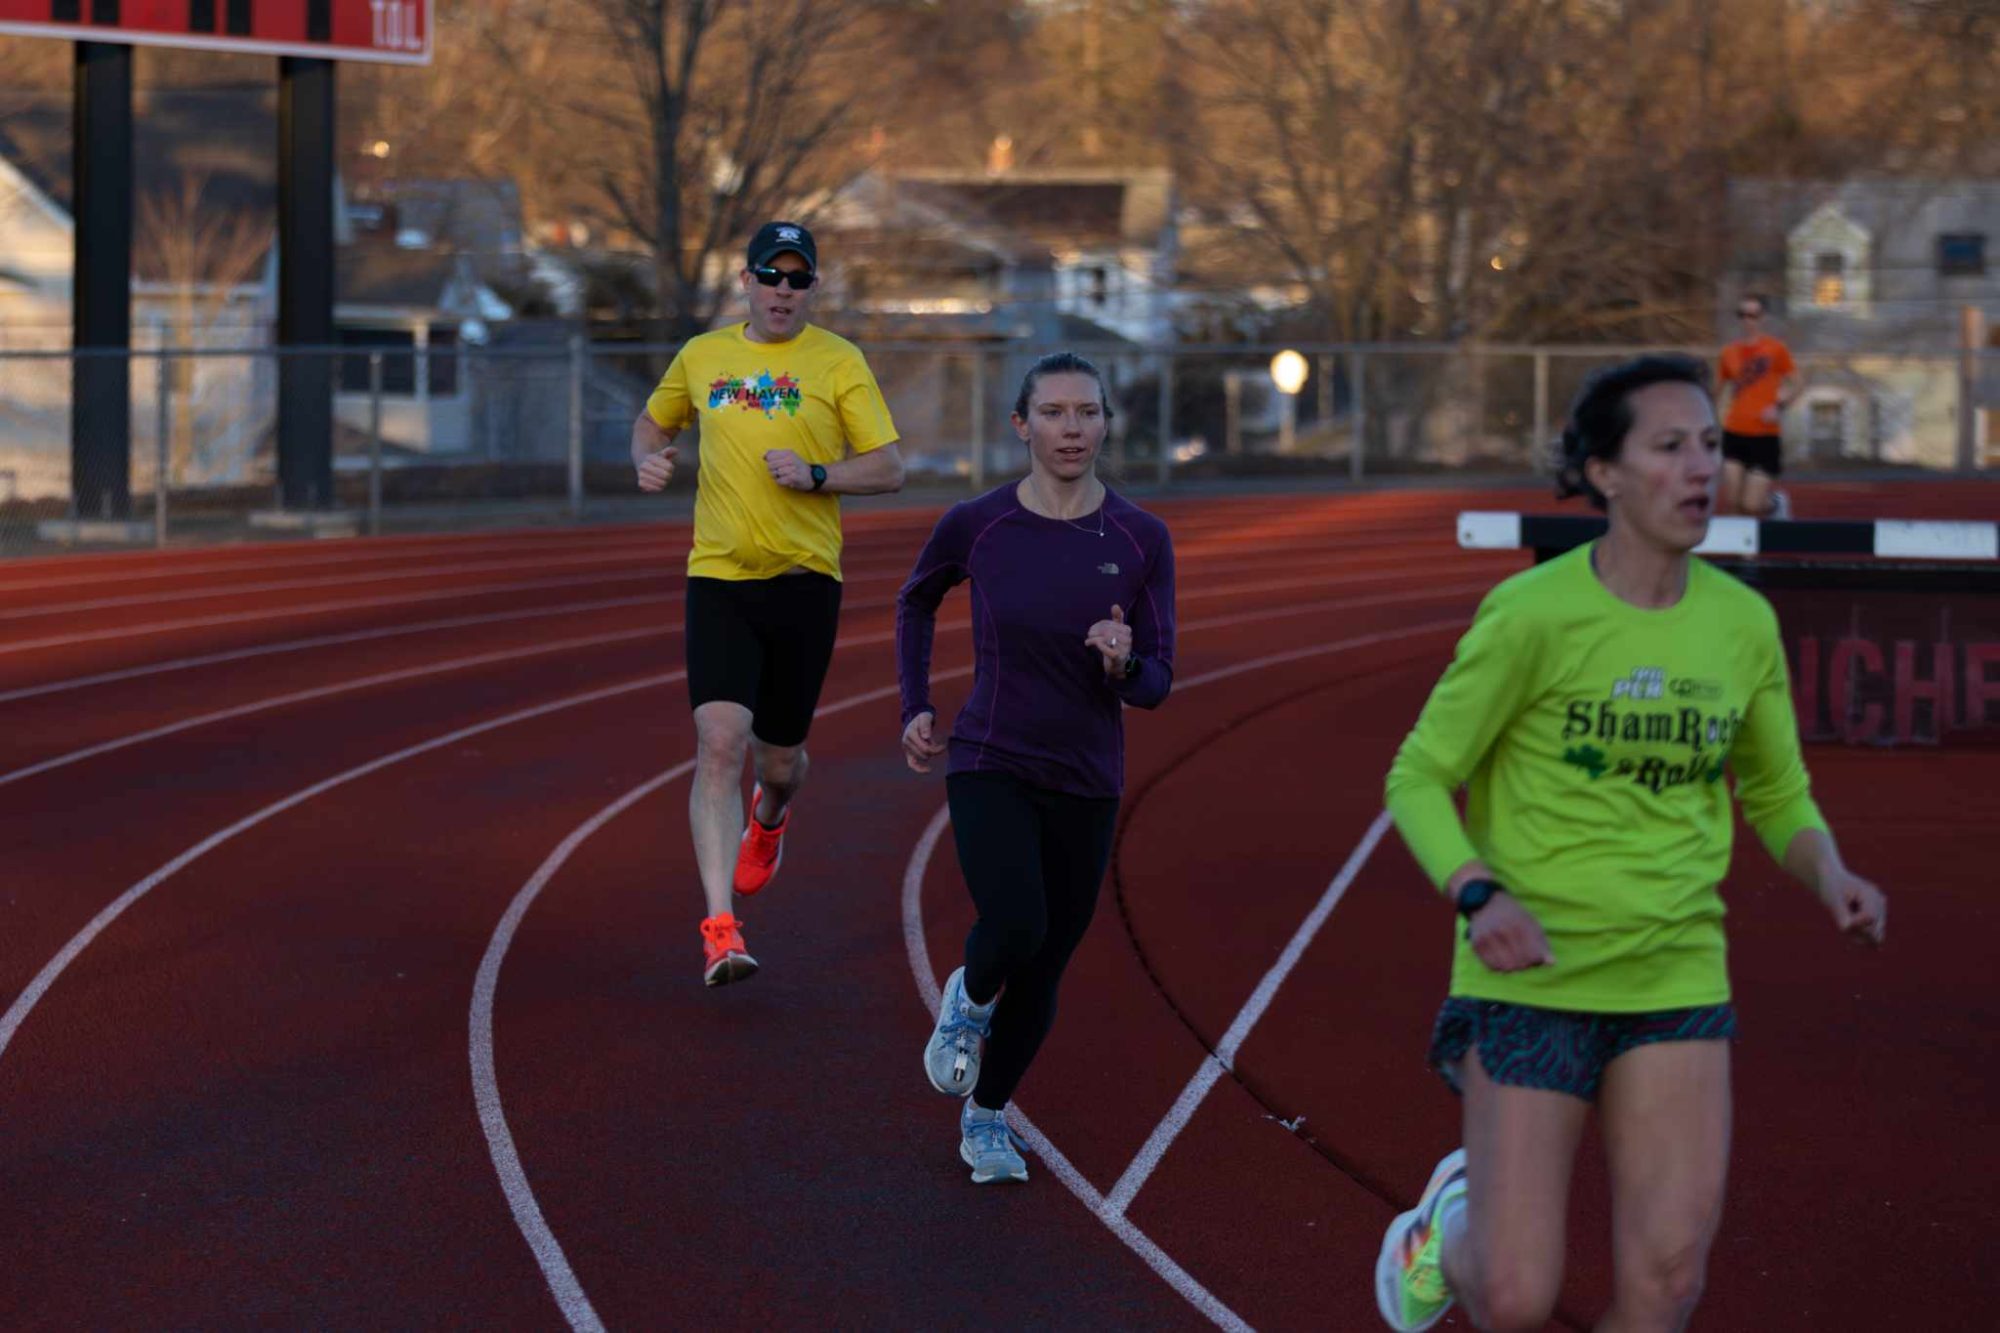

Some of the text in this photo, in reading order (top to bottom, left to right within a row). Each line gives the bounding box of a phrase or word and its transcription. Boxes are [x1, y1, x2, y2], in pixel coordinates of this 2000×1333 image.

[370, 0, 422, 48] TOL
[708, 386, 799, 400] NEW HAVEN
